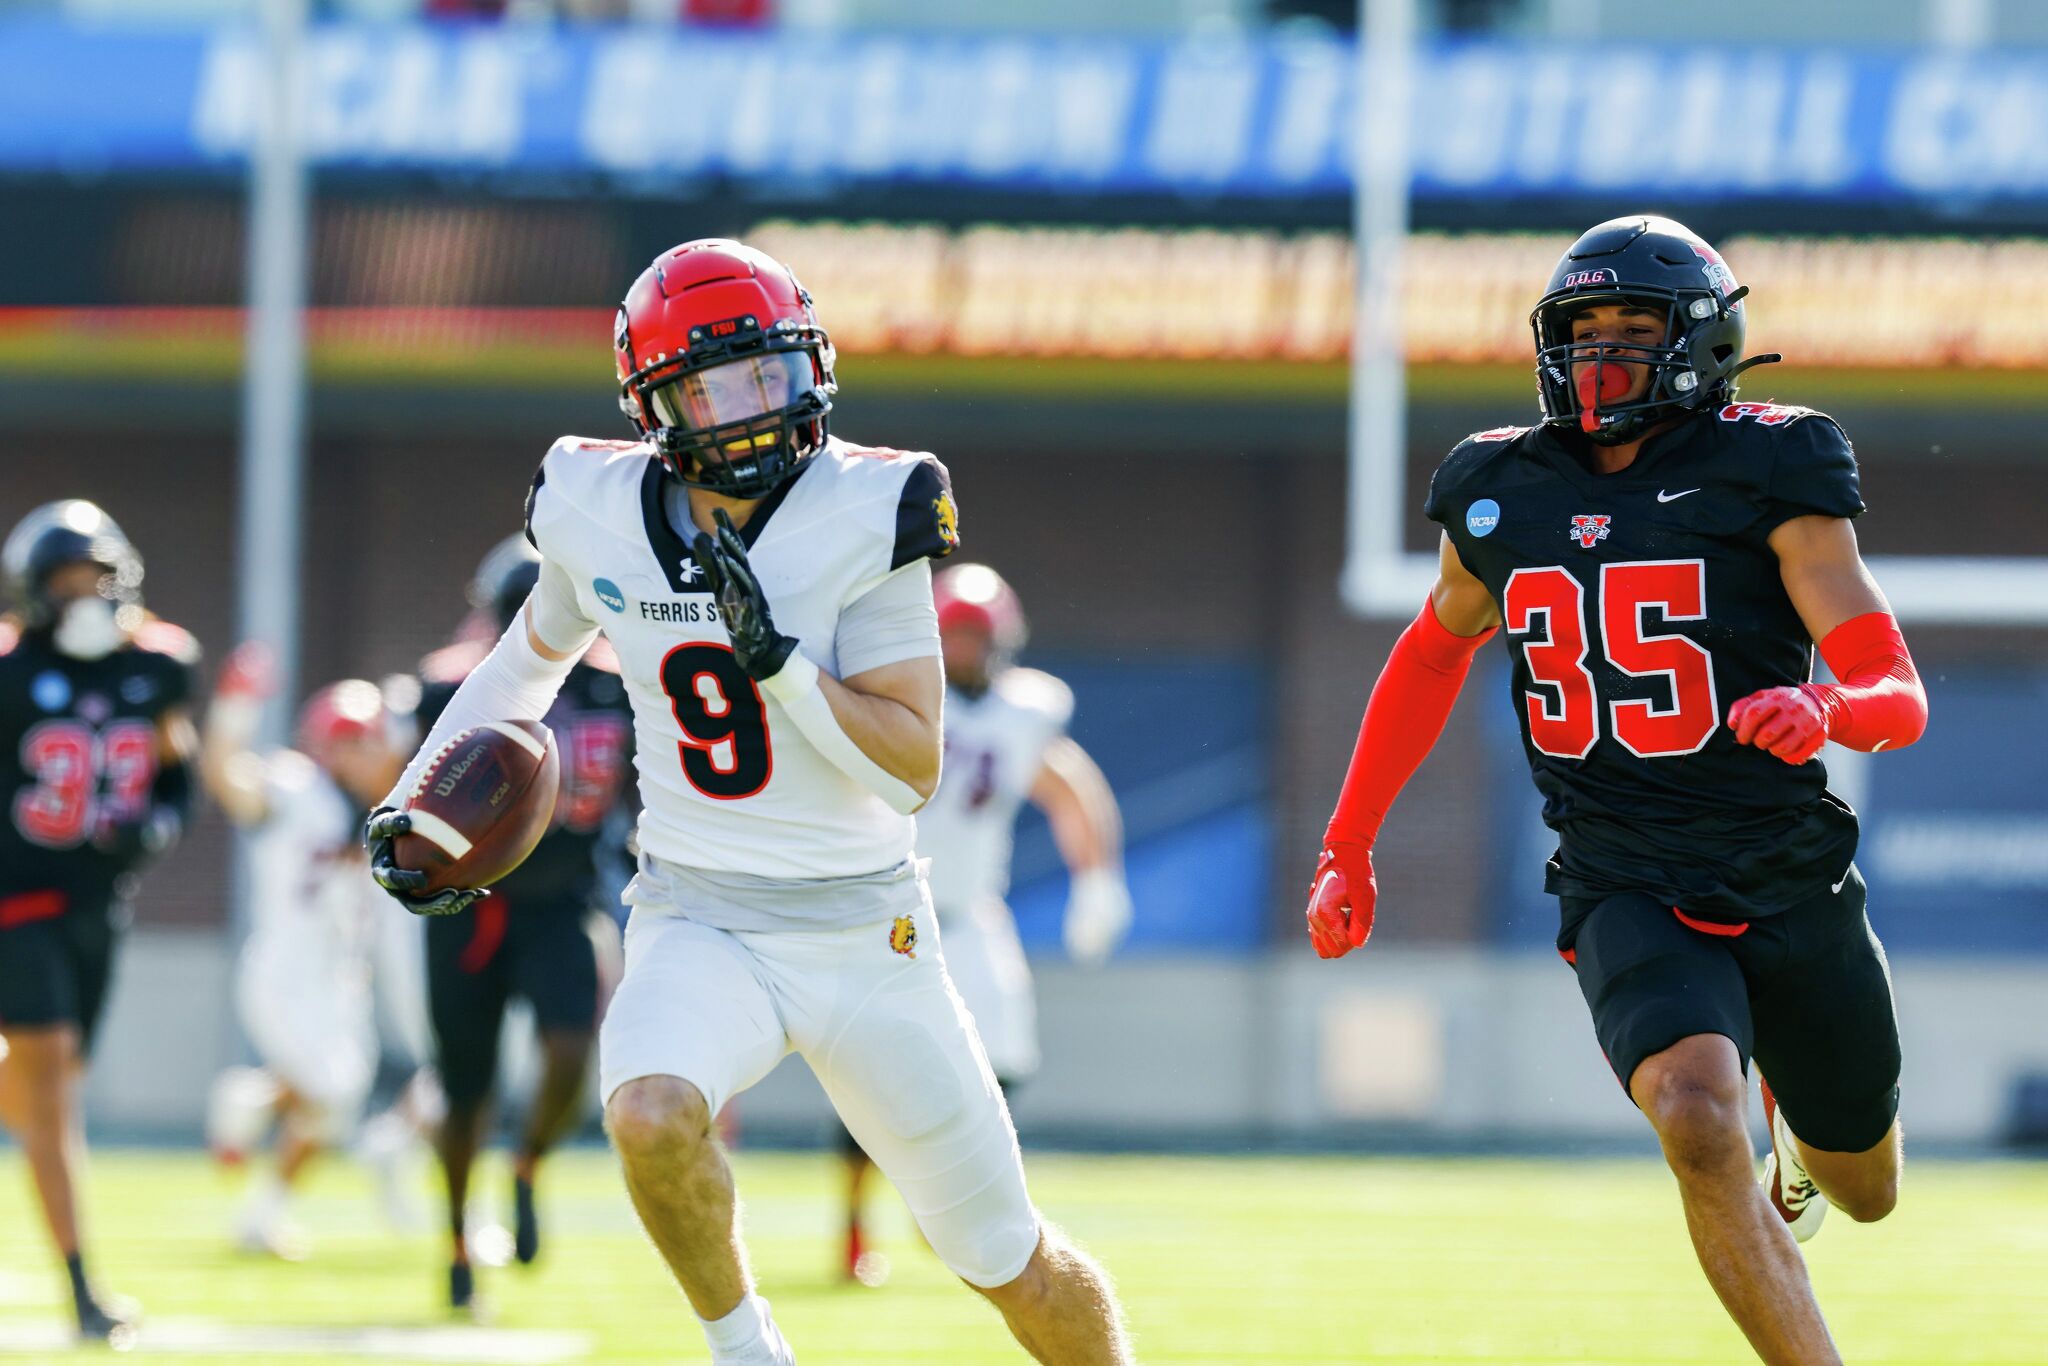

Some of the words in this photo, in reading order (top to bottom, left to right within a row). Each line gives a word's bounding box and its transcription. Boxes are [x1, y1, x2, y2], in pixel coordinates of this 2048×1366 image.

[1268, 46, 1856, 186] FOTBALL
[711, 320, 737, 337] FSU
[1470, 516, 1496, 527] NCAA
[640, 601, 700, 622] FERRIS
[706, 602, 717, 622] S
[1504, 558, 1720, 760] 35
[660, 641, 773, 800] 9
[434, 744, 487, 797] Wilson
